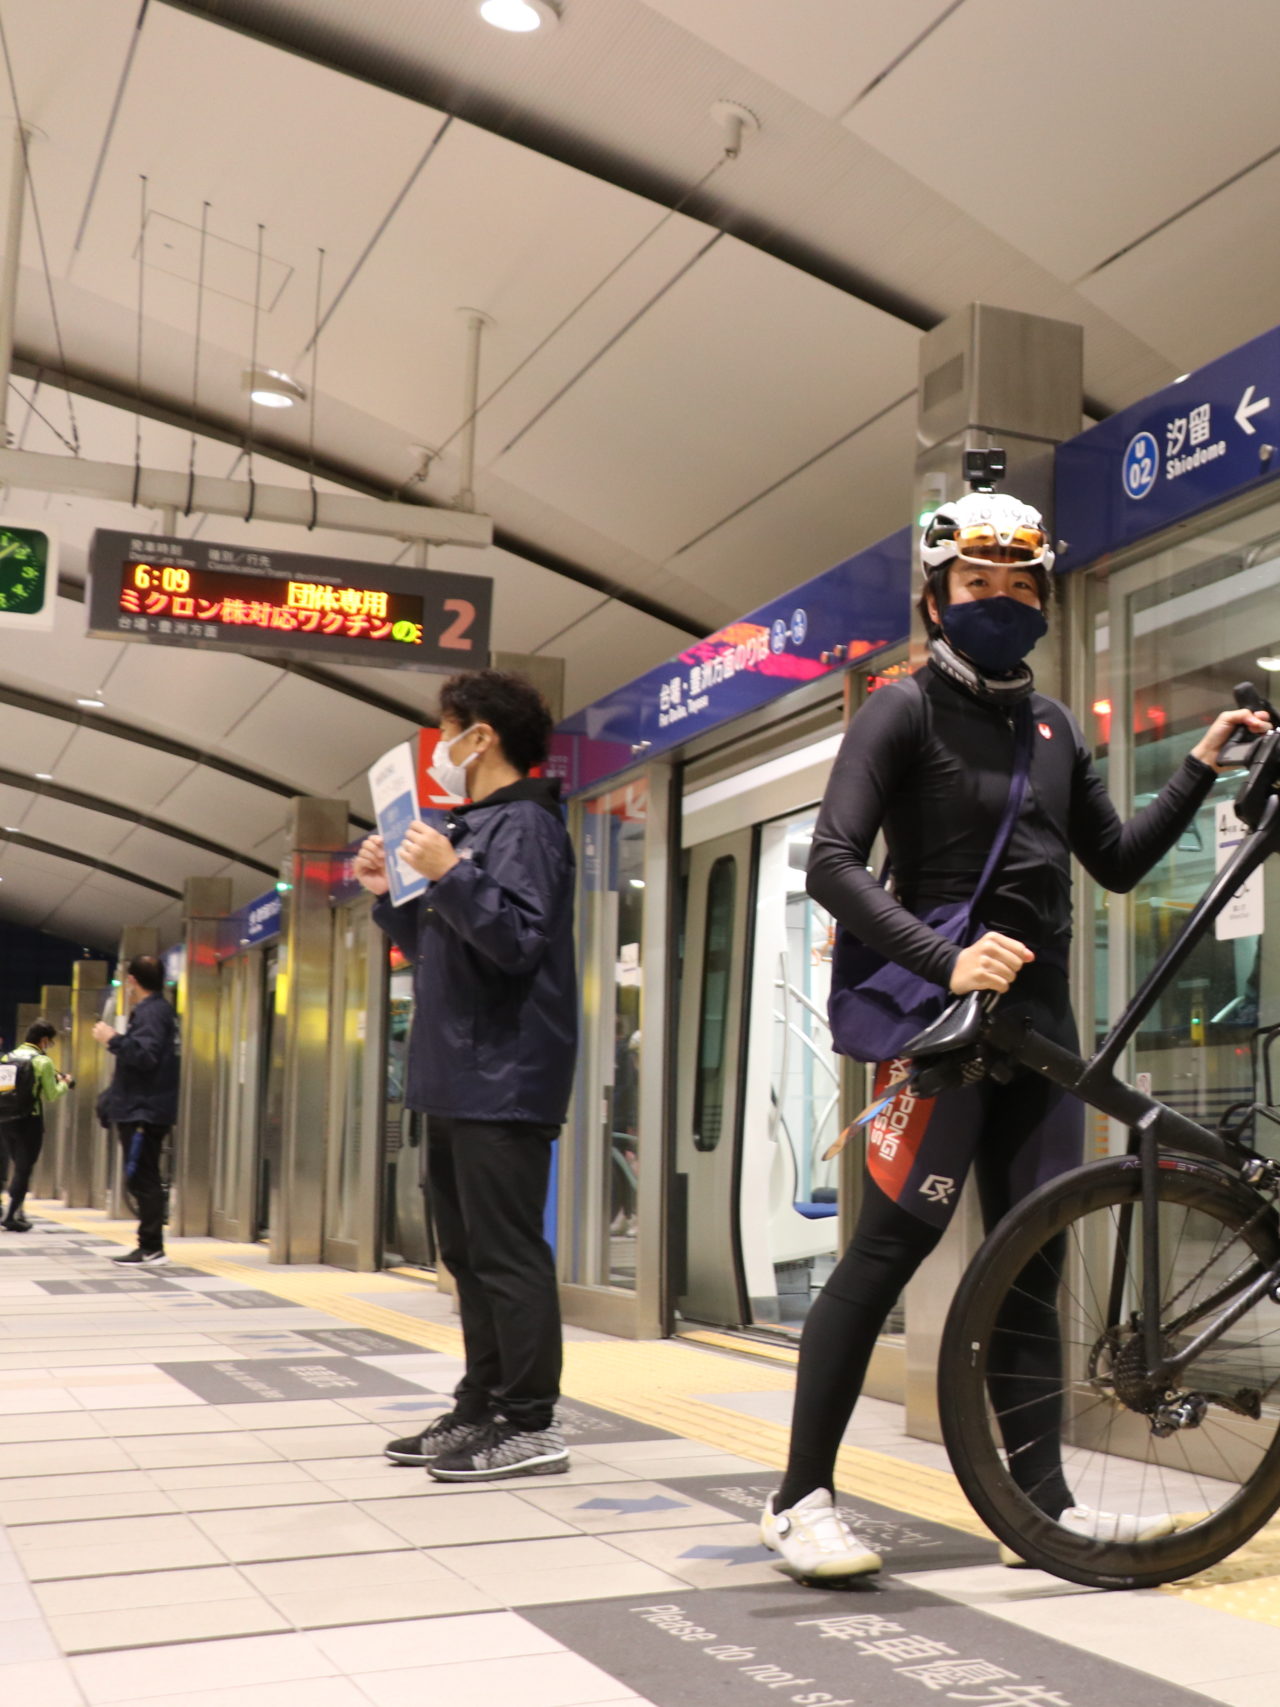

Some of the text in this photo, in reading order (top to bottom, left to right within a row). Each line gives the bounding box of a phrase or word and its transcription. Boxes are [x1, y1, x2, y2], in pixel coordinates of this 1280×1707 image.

[1134, 439, 1147, 460] U
[1165, 402, 1211, 458] 汐留
[1129, 456, 1152, 490] 02
[1166, 439, 1226, 481] Shiodome
[134, 563, 191, 594] 6:09
[287, 580, 390, 619] 団体専用
[437, 598, 477, 650] 2
[628, 1603, 719, 1642] Please
[702, 1644, 758, 1662] do
[738, 1663, 817, 1689] not
